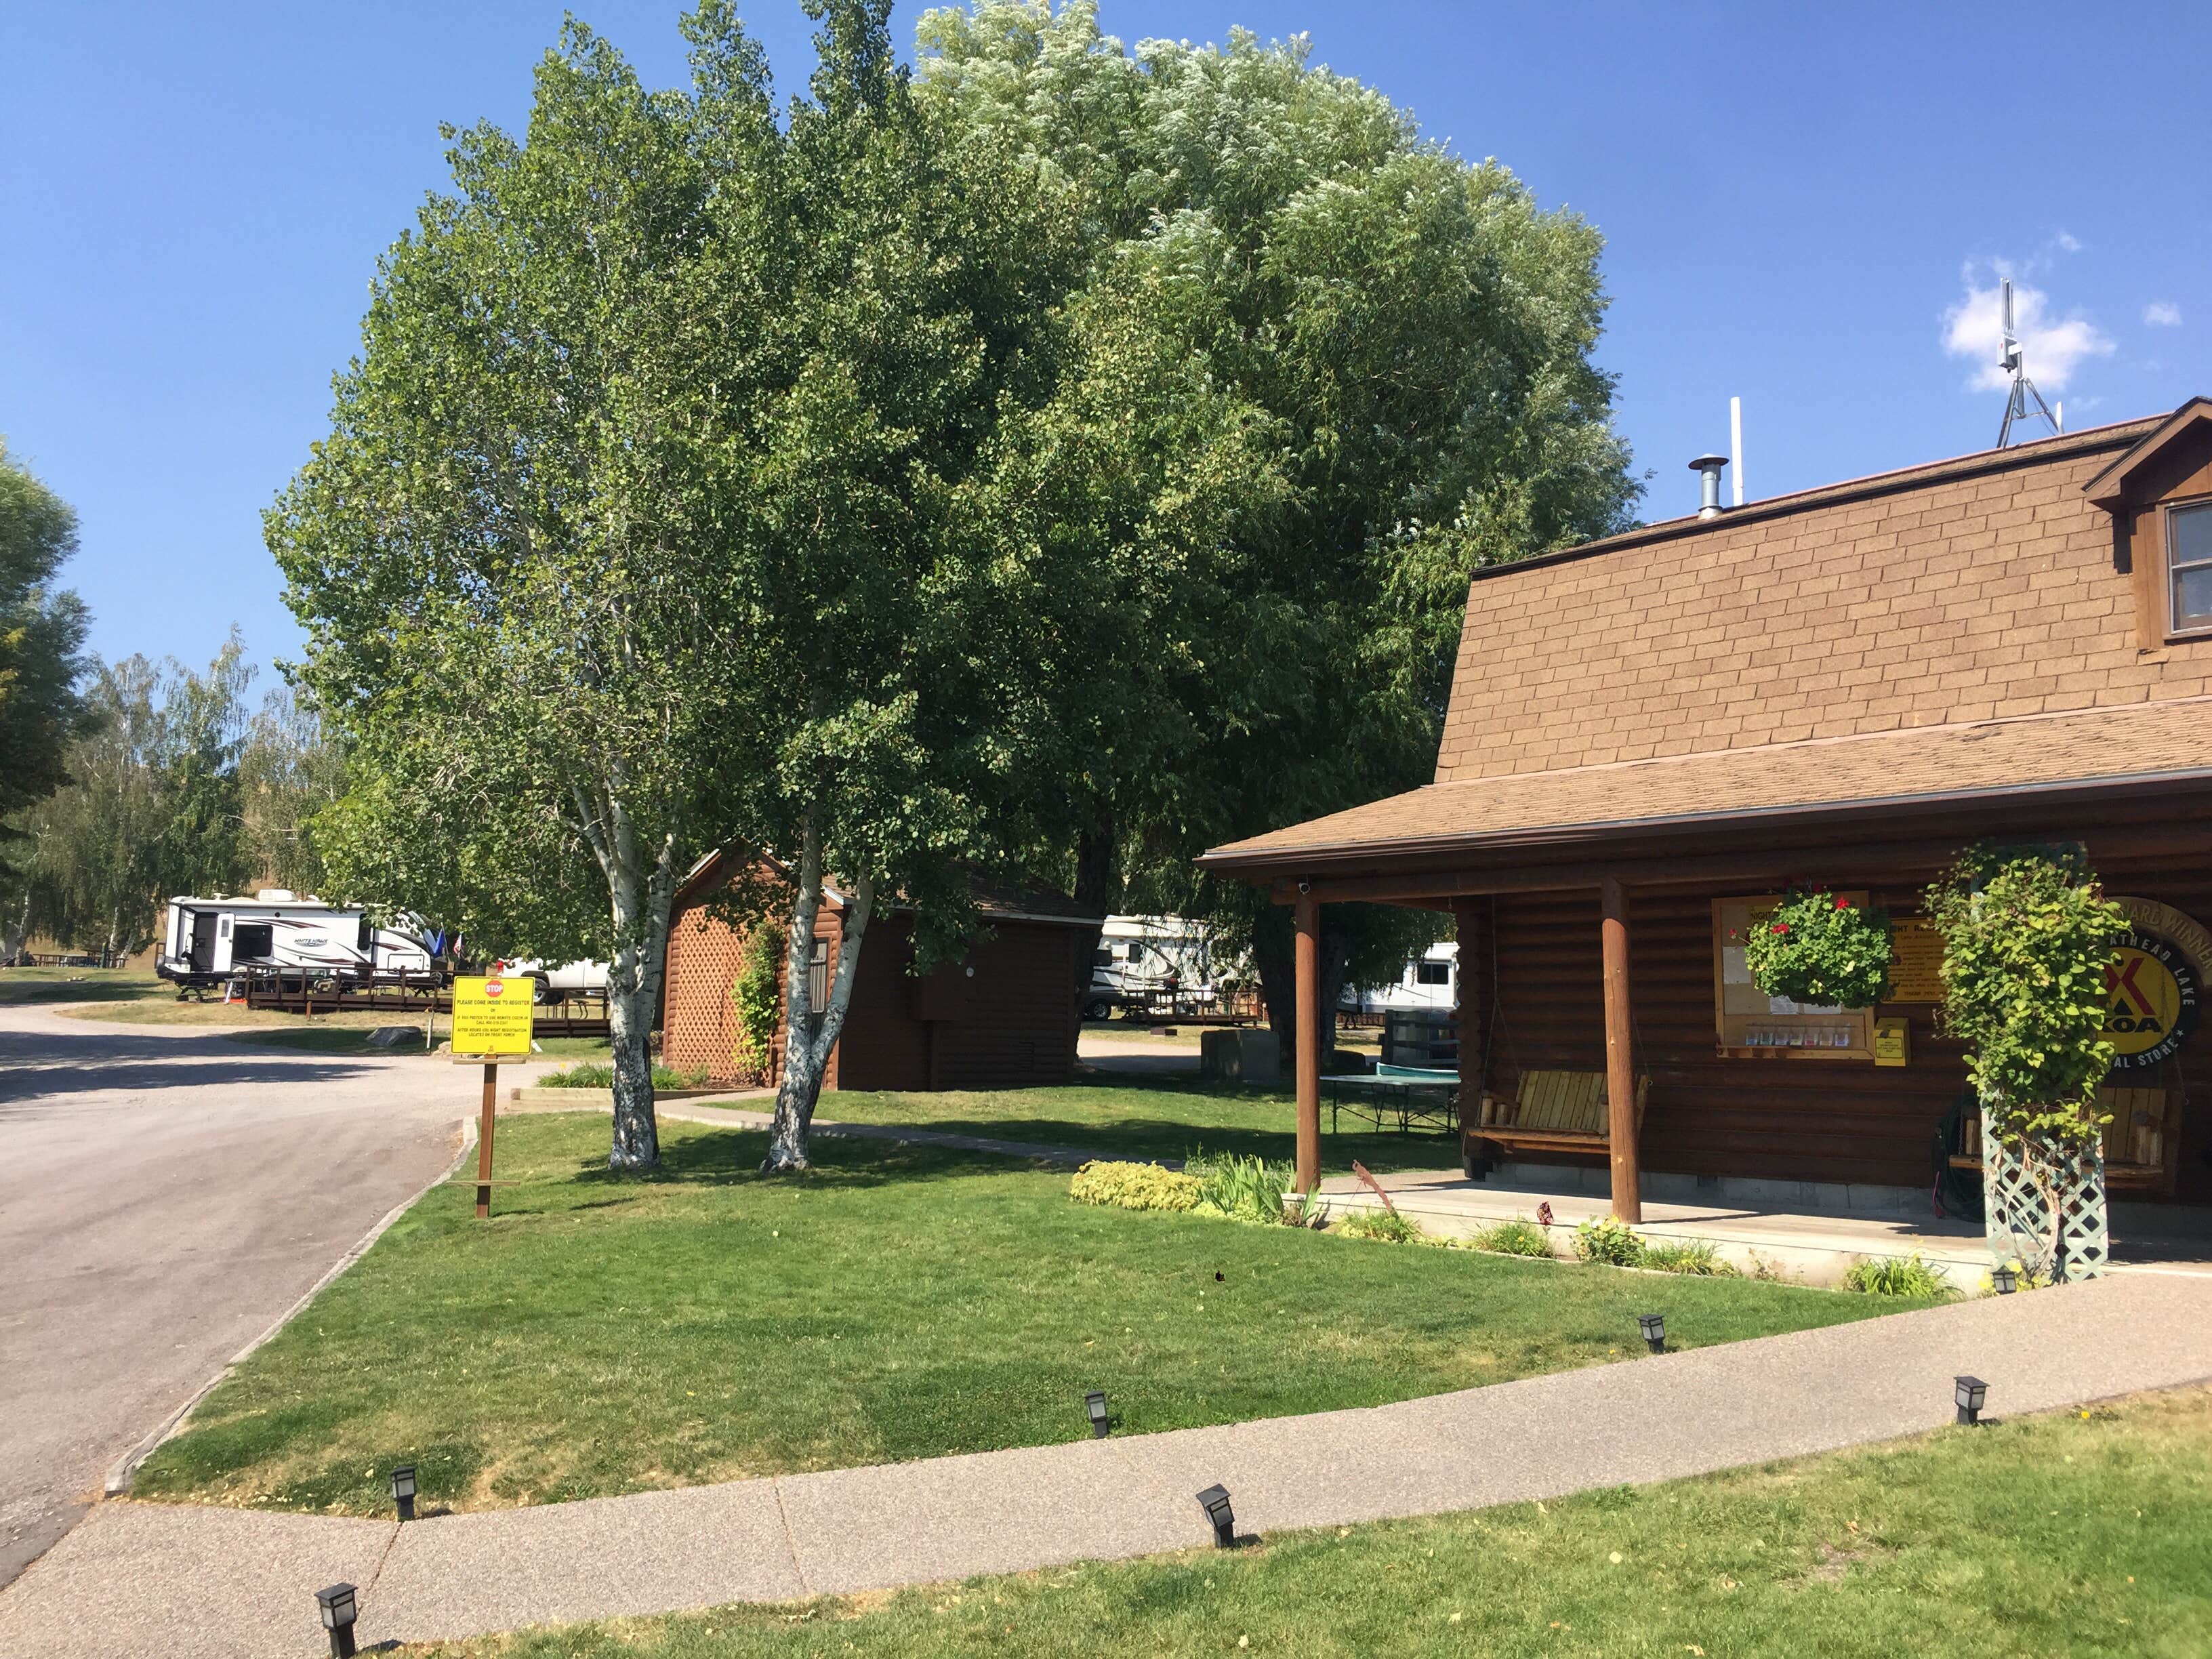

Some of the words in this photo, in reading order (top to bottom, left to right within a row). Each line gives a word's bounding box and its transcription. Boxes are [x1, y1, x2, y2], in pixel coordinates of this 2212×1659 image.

[1750, 911, 1771, 920] NIGHT
[2109, 933, 2173, 962] ATHEAD
[2173, 967, 2196, 1006] LAKE
[486, 984, 504, 993] STOP
[2137, 1038, 2179, 1067] STORE
